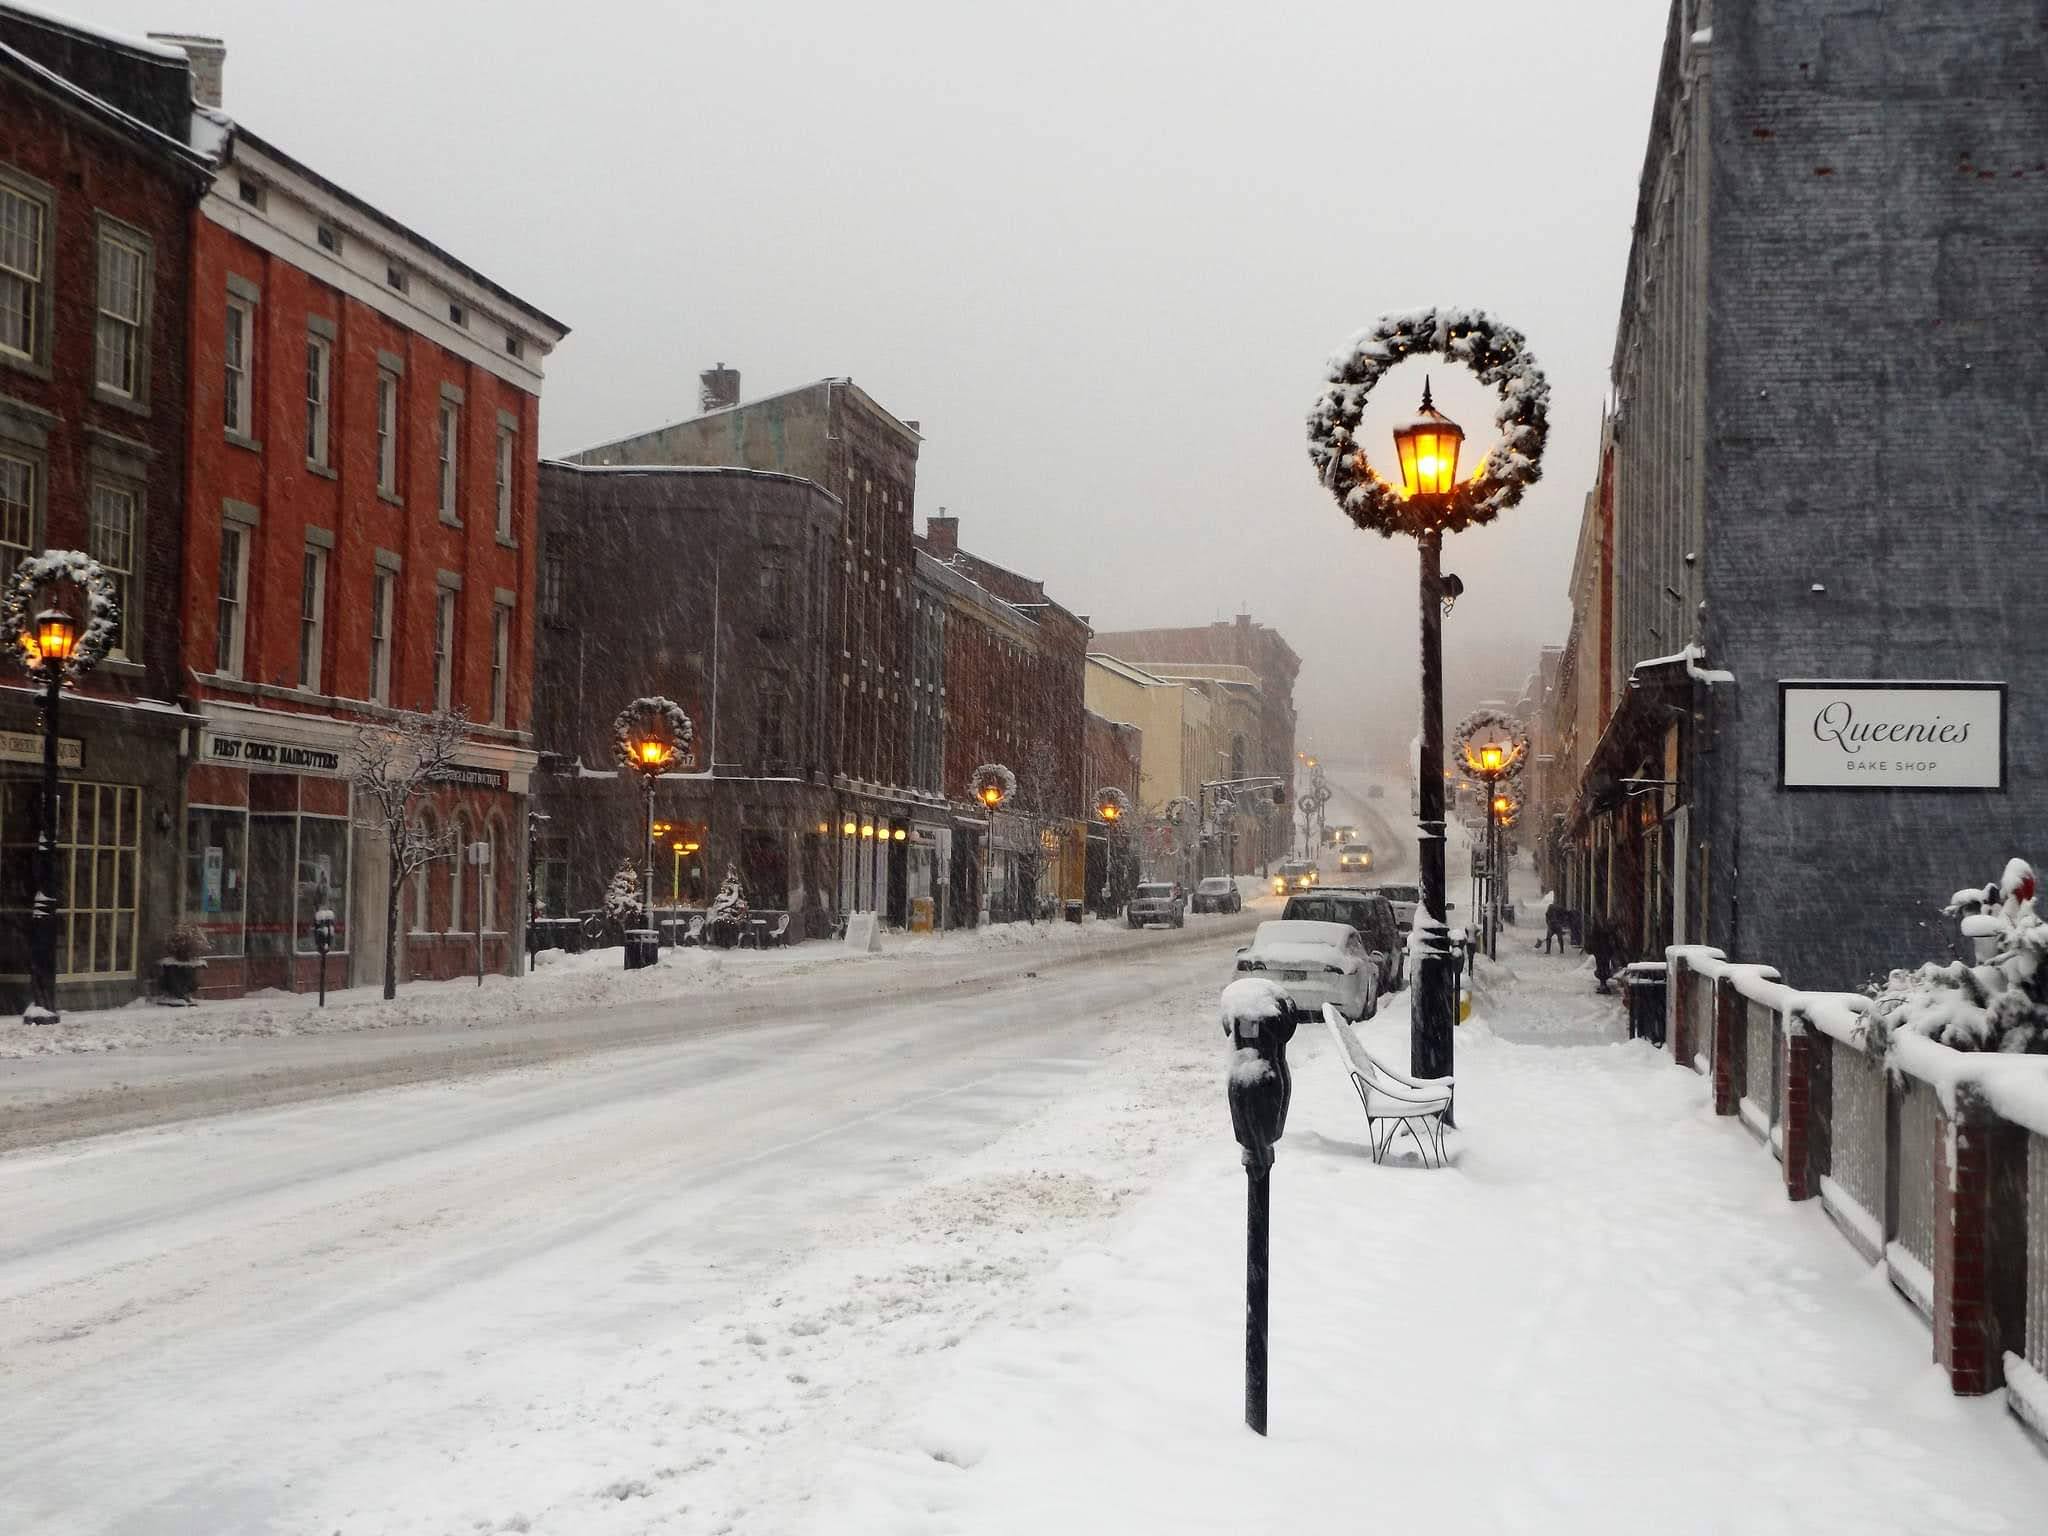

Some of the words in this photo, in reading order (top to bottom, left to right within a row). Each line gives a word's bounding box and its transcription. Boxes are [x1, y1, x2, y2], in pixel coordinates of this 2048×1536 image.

[1814, 701, 1970, 753] Queenies
[213, 738, 241, 757] FIRST
[244, 742, 277, 762] CHOICE
[279, 747, 339, 769] HAIRCUTTERS
[1847, 761, 1887, 771] BAKE
[1896, 762, 1937, 771] SHOP
